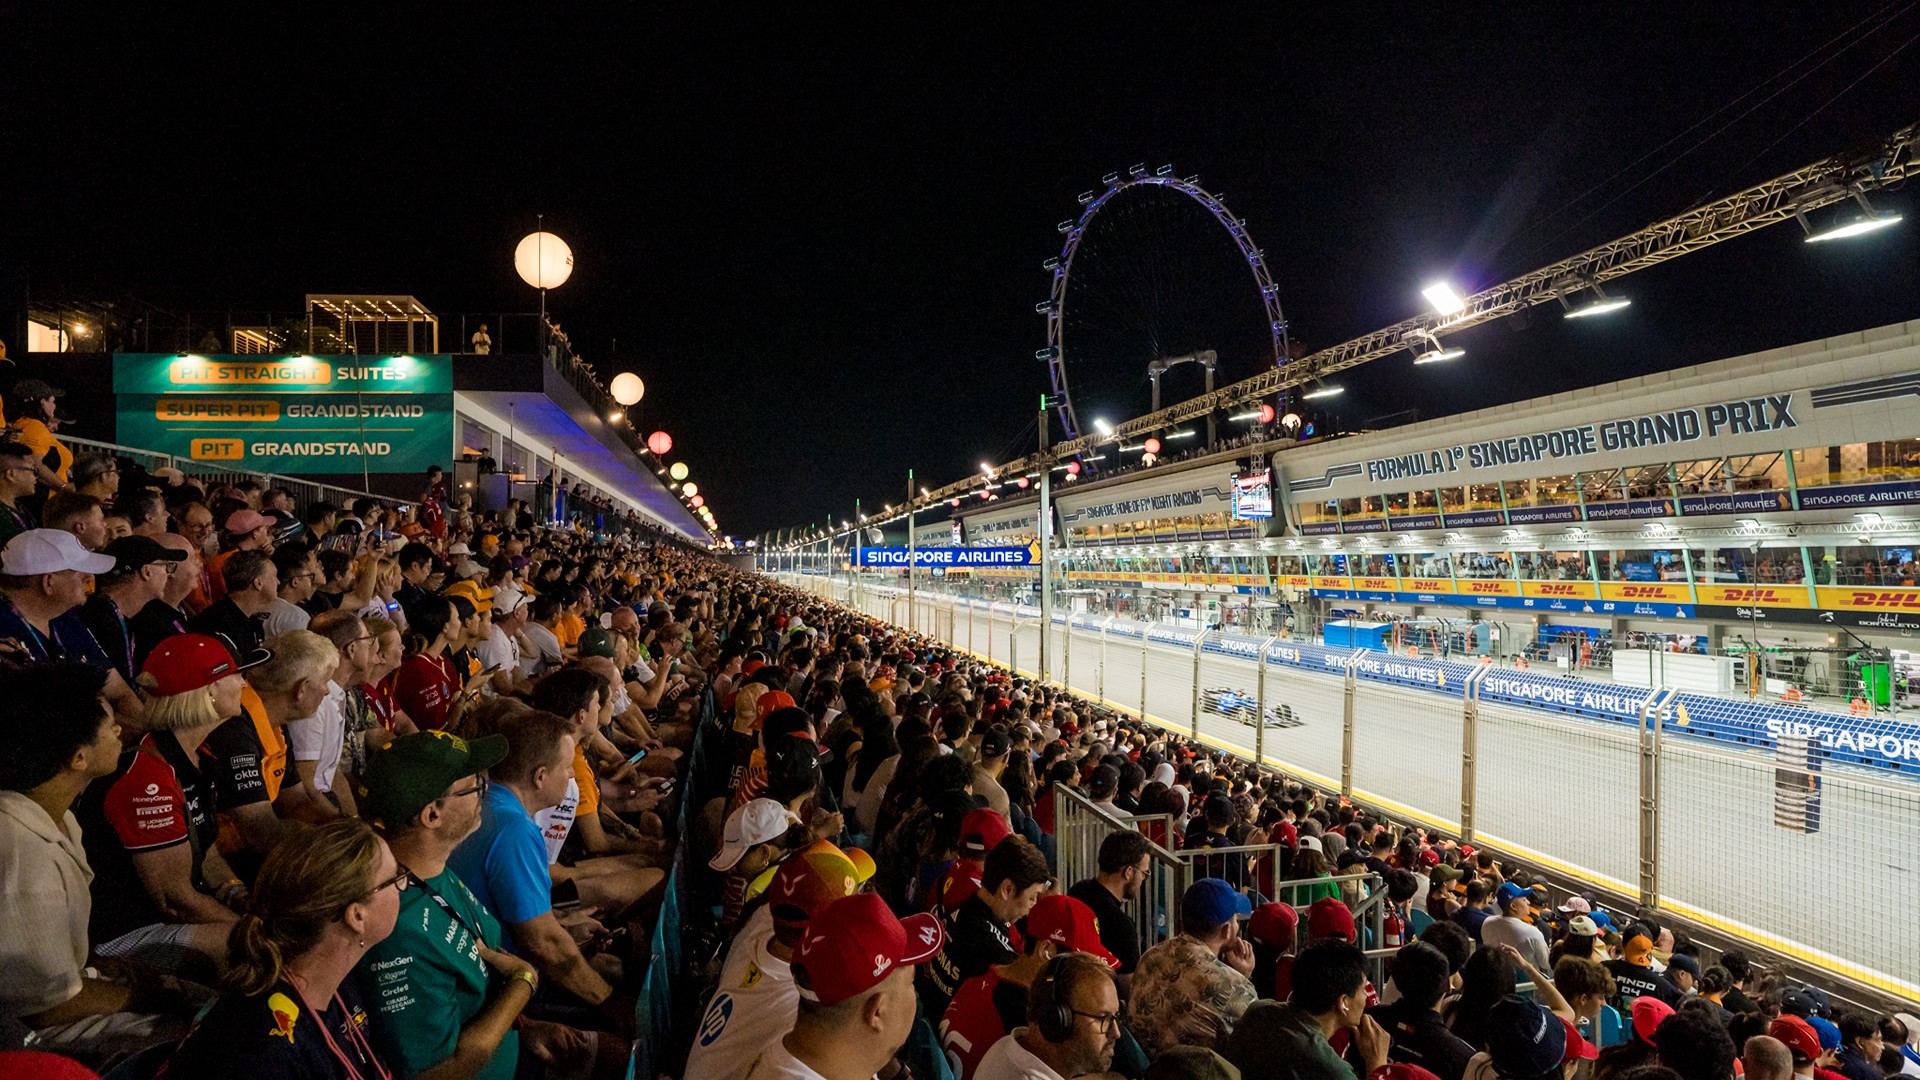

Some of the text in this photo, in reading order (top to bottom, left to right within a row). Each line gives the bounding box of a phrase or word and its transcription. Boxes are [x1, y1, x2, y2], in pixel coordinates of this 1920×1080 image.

[180, 366, 406, 381] PIT STRAIGHT SUITES
[167, 404, 423, 419] SUPER PIT GRANDSTAND
[1367, 450, 1446, 482] FORMULA
[1469, 424, 1600, 469] SINGAPORE
[1600, 408, 1702, 452] GRAND
[1705, 393, 1799, 437] PRIX
[201, 442, 391, 456] PIT GRANDSTAND
[1802, 492, 1865, 505] SINGAPORE
[1588, 505, 1663, 518] SINGAPORE AIRLINES
[1683, 499, 1777, 513] SINGAPORE AIRLINES
[1511, 514, 1543, 522] SINGAPORE
[867, 551, 1023, 563] SINGAPORE AIRLINES
[1322, 579, 1342, 587] DHL
[1364, 580, 1388, 588] DHL
[1414, 581, 1441, 590] DHL
[1471, 582, 1503, 593] DHL
[1540, 584, 1577, 595] DHL
[1622, 586, 1668, 598] DHL
[1723, 588, 1780, 603] DHL
[1852, 592, 1920, 608] DHL
[1858, 620, 1920, 629] BORTOLETO
[1220, 639, 1257, 654] SINGAPORE
[1383, 663, 1435, 683] AIRLINES
[1485, 678, 1575, 706] SINGAPORE
[234, 769, 259, 780] okta
[237, 780, 262, 790] FxPro
[132, 795, 173, 803] MoneyGram
[136, 804, 173, 815] PIRELLI
[147, 816, 174, 825] UChicago
[147, 820, 174, 830] Medicine
[918, 926, 937, 945] 44
[377, 956, 413, 971] NexGen
[1621, 986, 1641, 996] 04
